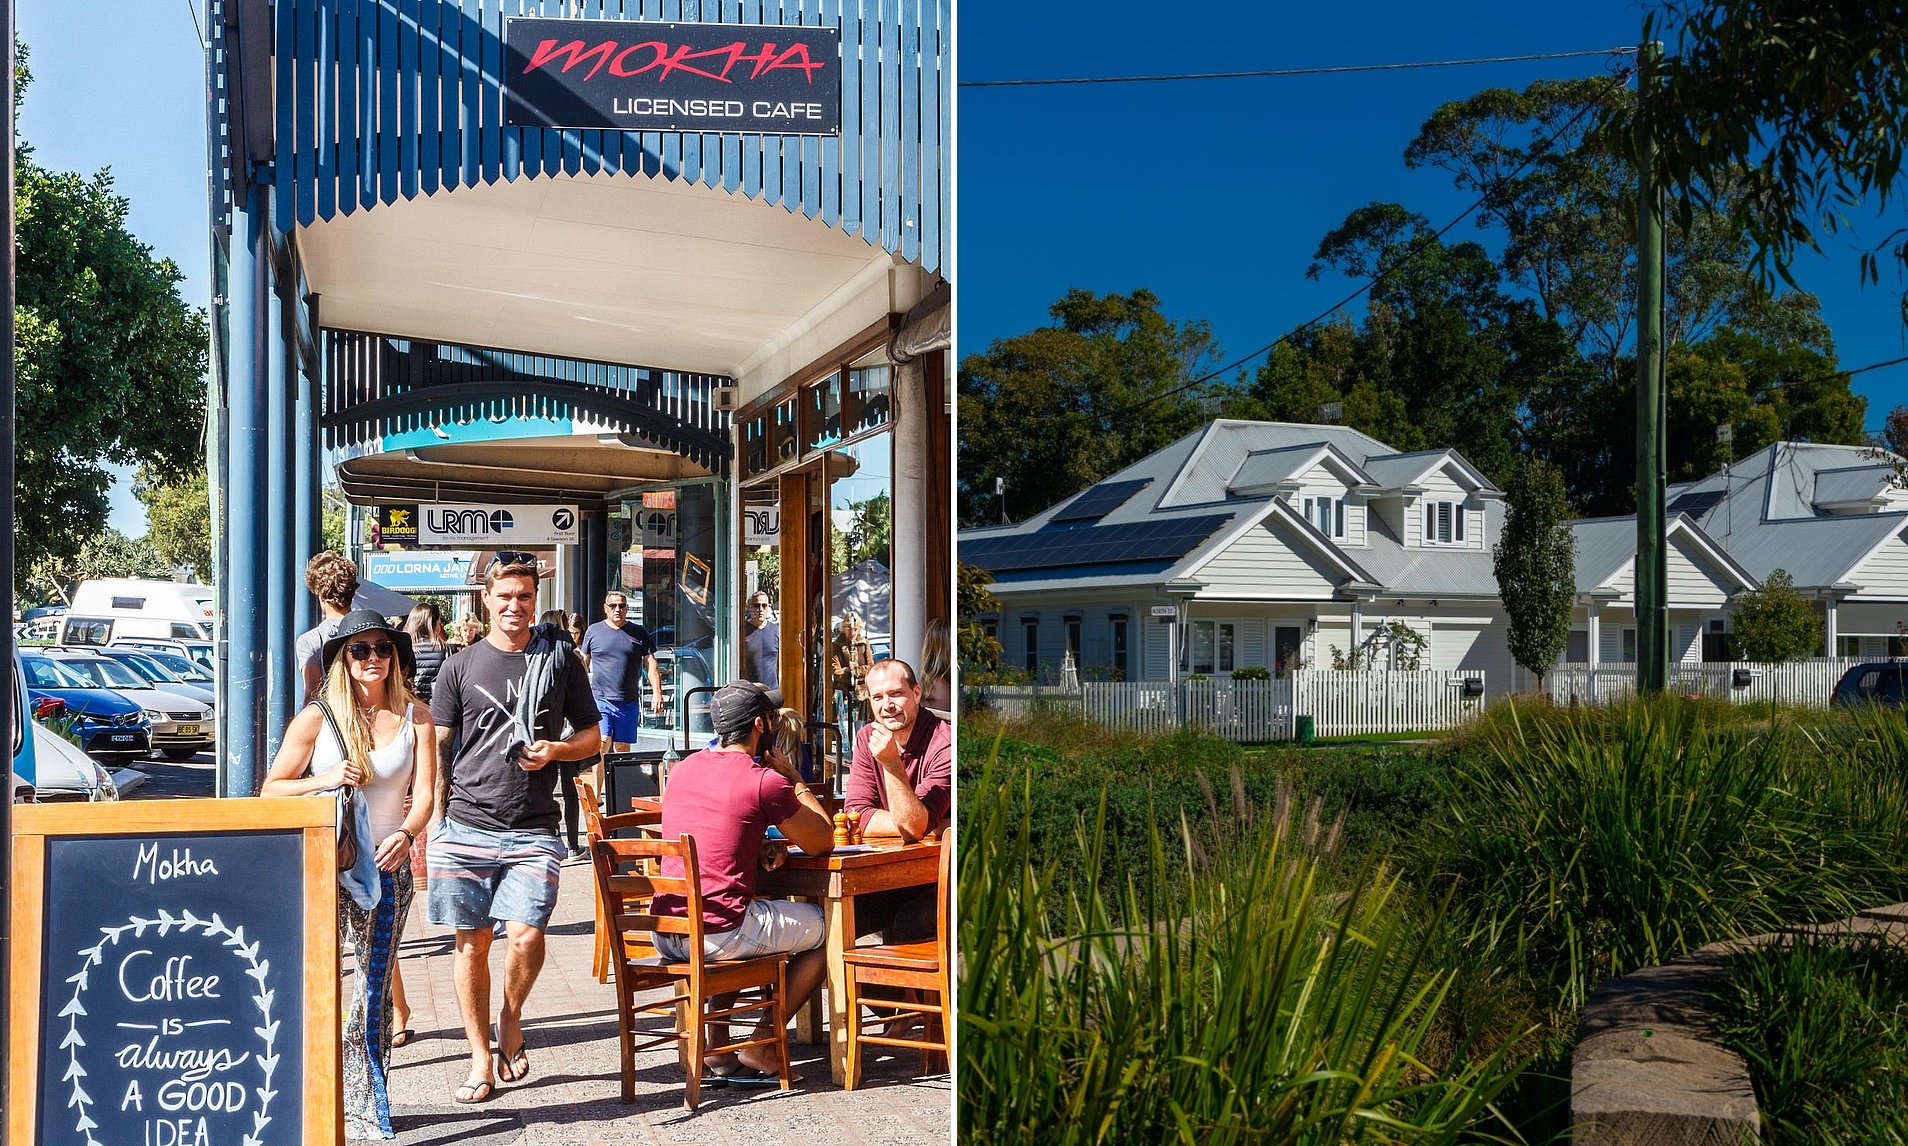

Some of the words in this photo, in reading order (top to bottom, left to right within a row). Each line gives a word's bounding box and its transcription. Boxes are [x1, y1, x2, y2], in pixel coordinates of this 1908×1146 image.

[522, 39, 825, 85] MOKHA
[613, 97, 744, 118] LICENSED
[752, 101, 822, 120] CAFE
[396, 563, 441, 574] LORNA
[443, 562, 468, 573] JAN
[133, 841, 219, 885] Mokha
[118, 950, 221, 1002] Coffee
[162, 1018, 184, 1035] IS
[114, 1035, 250, 1082] always
[121, 1079, 143, 1112] A
[157, 1079, 246, 1113] GOOD
[145, 1115, 209, 1146] IDEA
